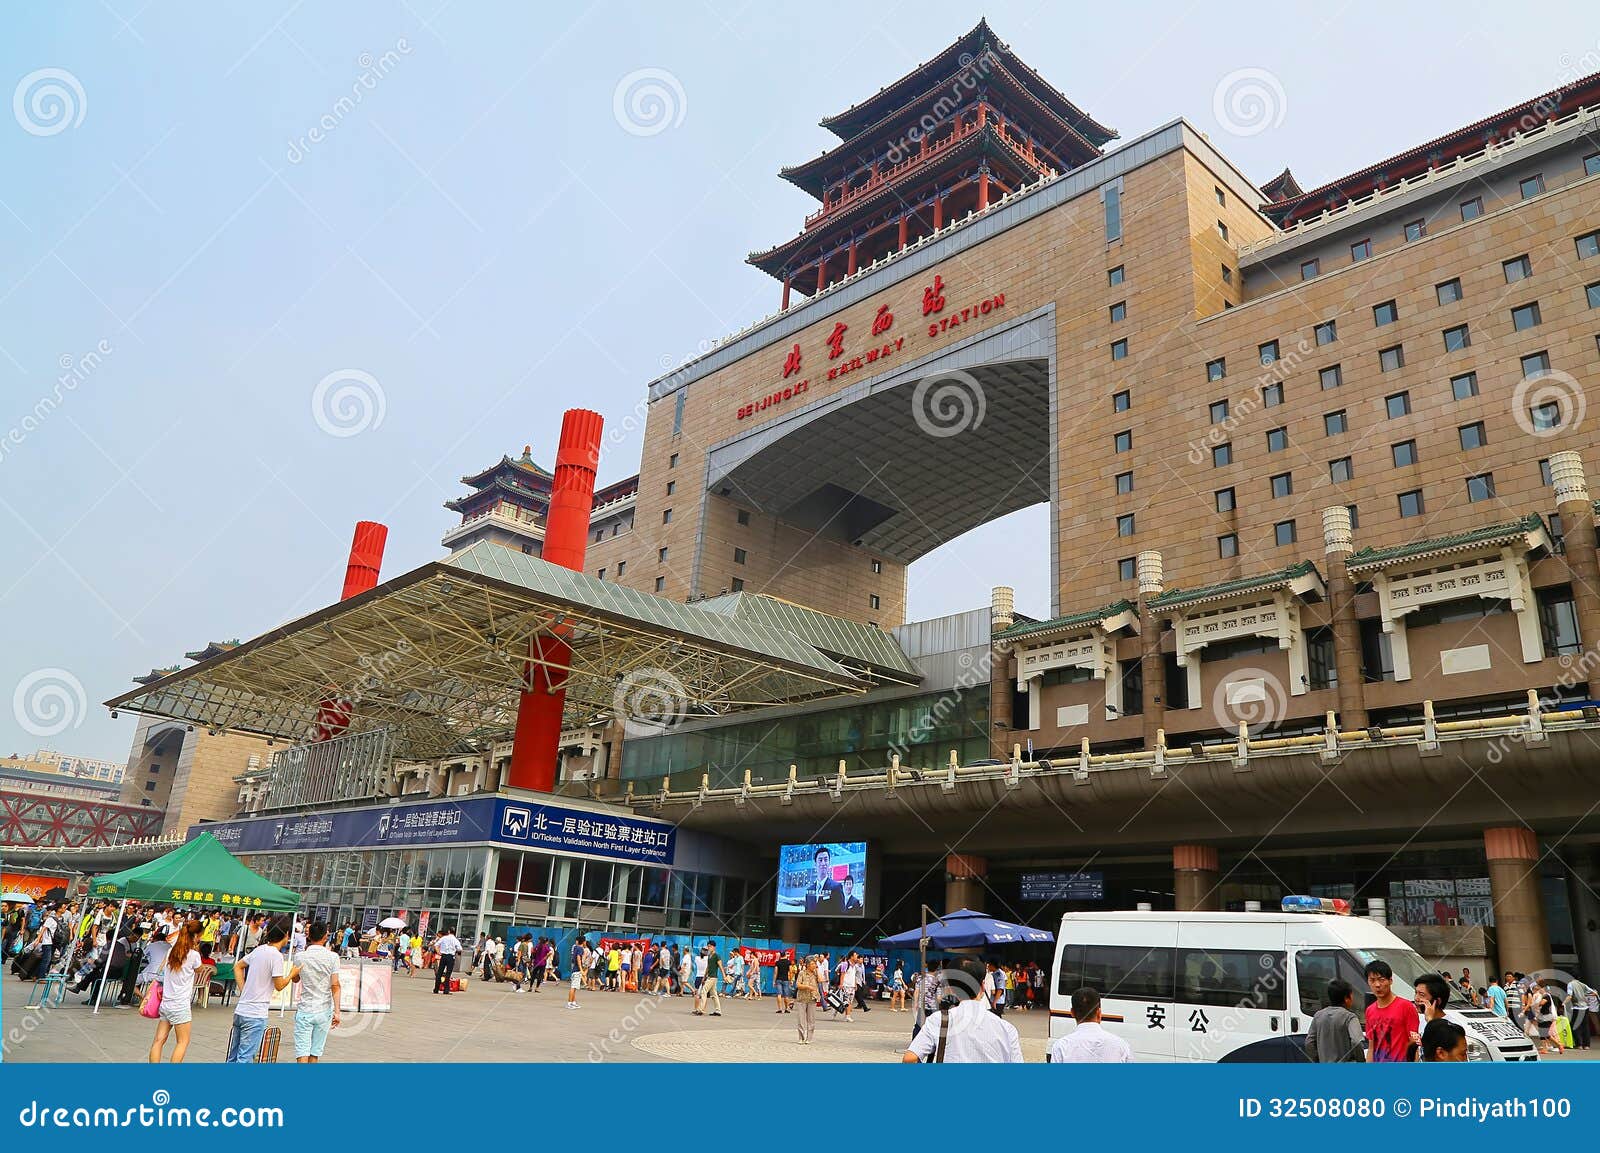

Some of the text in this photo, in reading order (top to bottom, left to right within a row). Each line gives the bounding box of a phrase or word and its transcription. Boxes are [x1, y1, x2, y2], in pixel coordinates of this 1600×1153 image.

[783, 275, 945, 378] 北京西站
[736, 293, 1006, 420] BEIJINGXI RAILWAY STATION
[531, 832, 667, 857] ID/Tickets Validation North First Layer Entrance
[534, 813, 669, 847] 北一层验证验票进站口
[171, 890, 262, 906] 无偿献血 挽救生命
